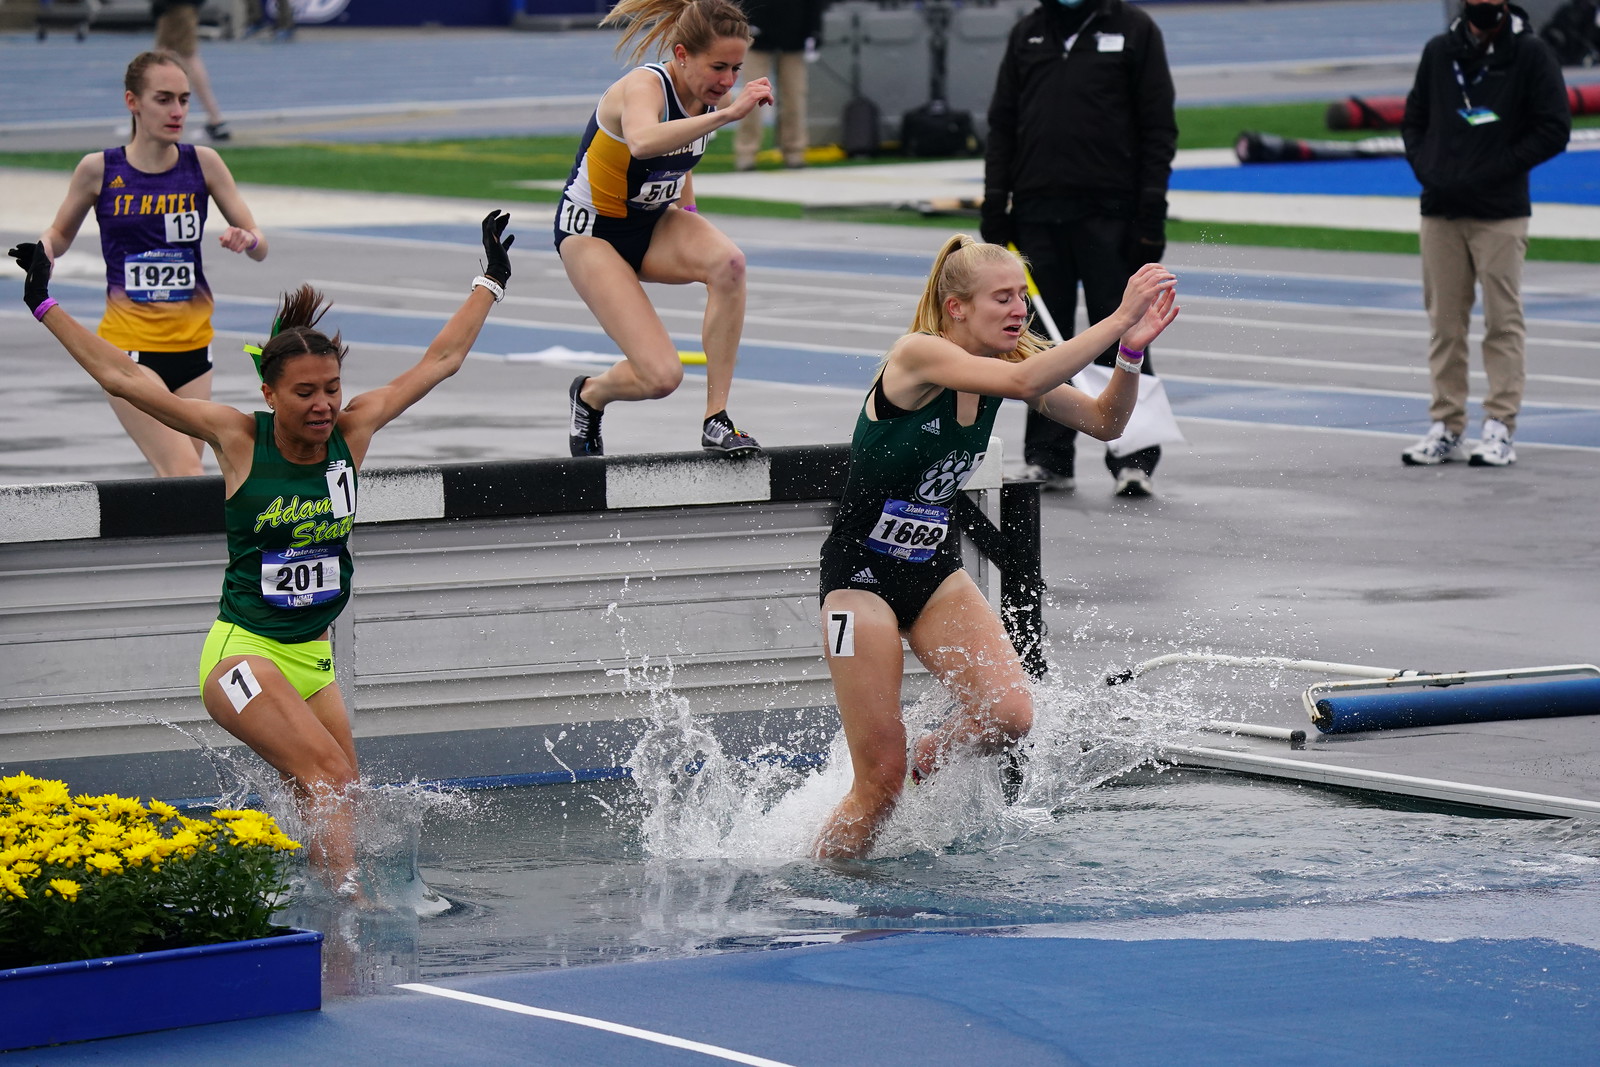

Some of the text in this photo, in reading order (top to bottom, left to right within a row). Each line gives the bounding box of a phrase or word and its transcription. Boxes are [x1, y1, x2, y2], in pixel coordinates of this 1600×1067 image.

[113, 195, 135, 216] ST.
[566, 204, 590, 235] 10
[172, 213, 196, 240] 13
[130, 265, 191, 287] 1929
[336, 471, 352, 513] 1
[254, 495, 333, 533] Adam
[905, 503, 925, 515] Drake
[880, 518, 943, 547] 1668
[284, 548, 309, 558] Drake
[276, 561, 324, 592] 201
[851, 575, 879, 584] adidas
[831, 613, 848, 655] 7
[230, 667, 254, 700] 1
